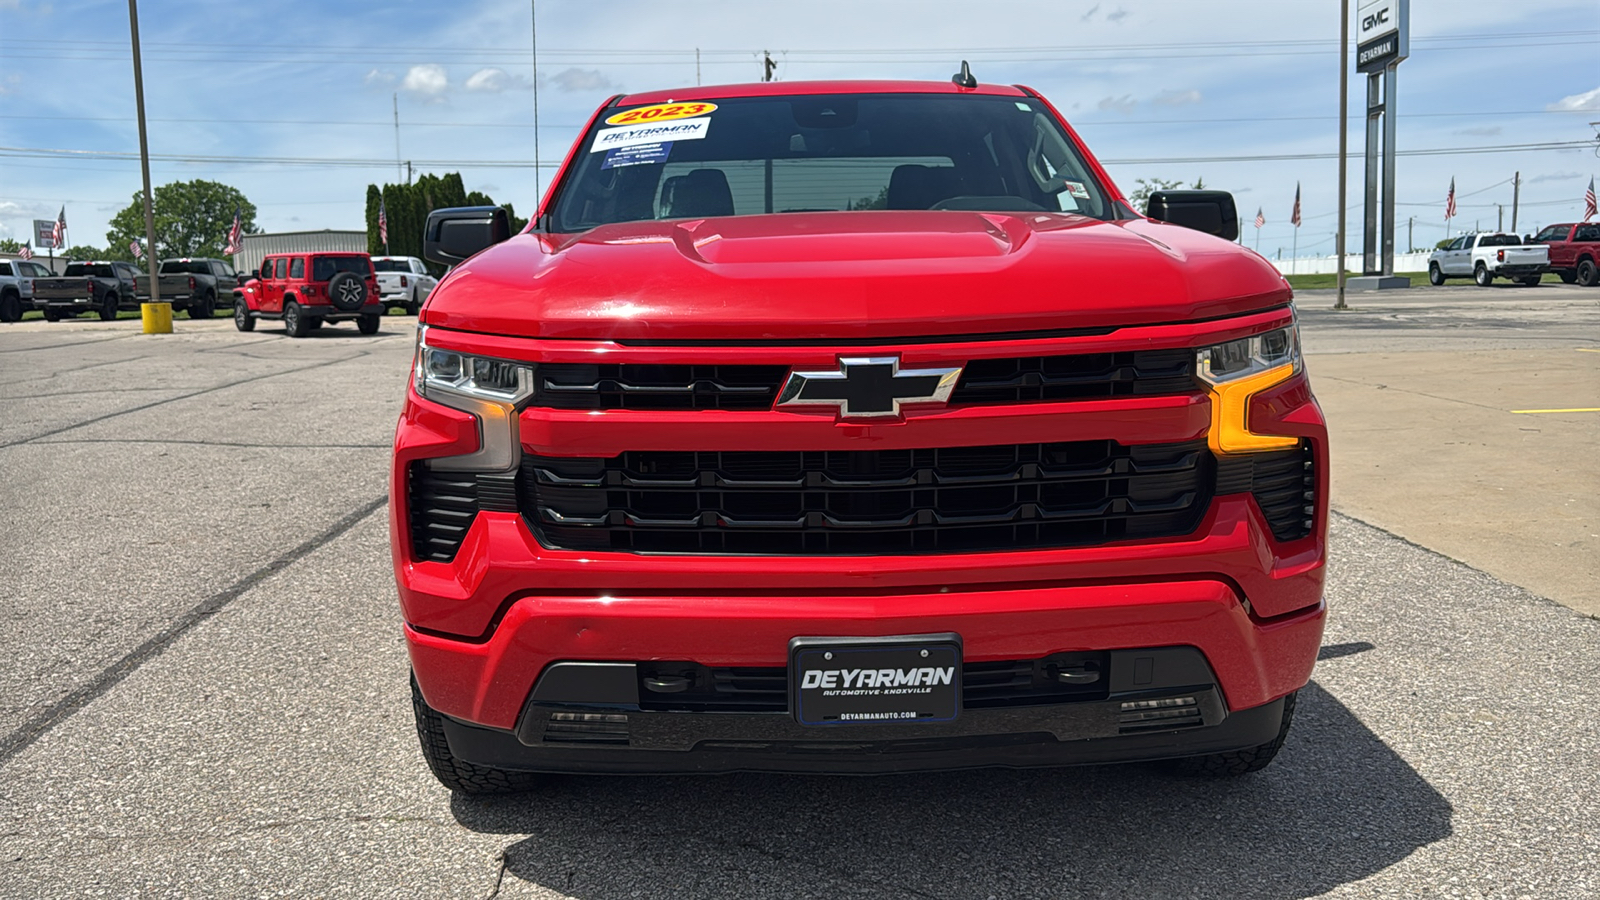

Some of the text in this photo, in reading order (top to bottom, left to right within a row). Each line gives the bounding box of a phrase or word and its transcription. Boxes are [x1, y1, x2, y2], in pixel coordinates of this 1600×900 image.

[1362, 7, 1389, 32] GMC
[1360, 41, 1391, 63] DEYARMAN
[617, 104, 708, 123] 2023
[602, 123, 703, 141] DEYARMAN
[801, 666, 955, 689] DEYARMAN
[840, 712, 917, 720] DEYARMANAUTO.COM
